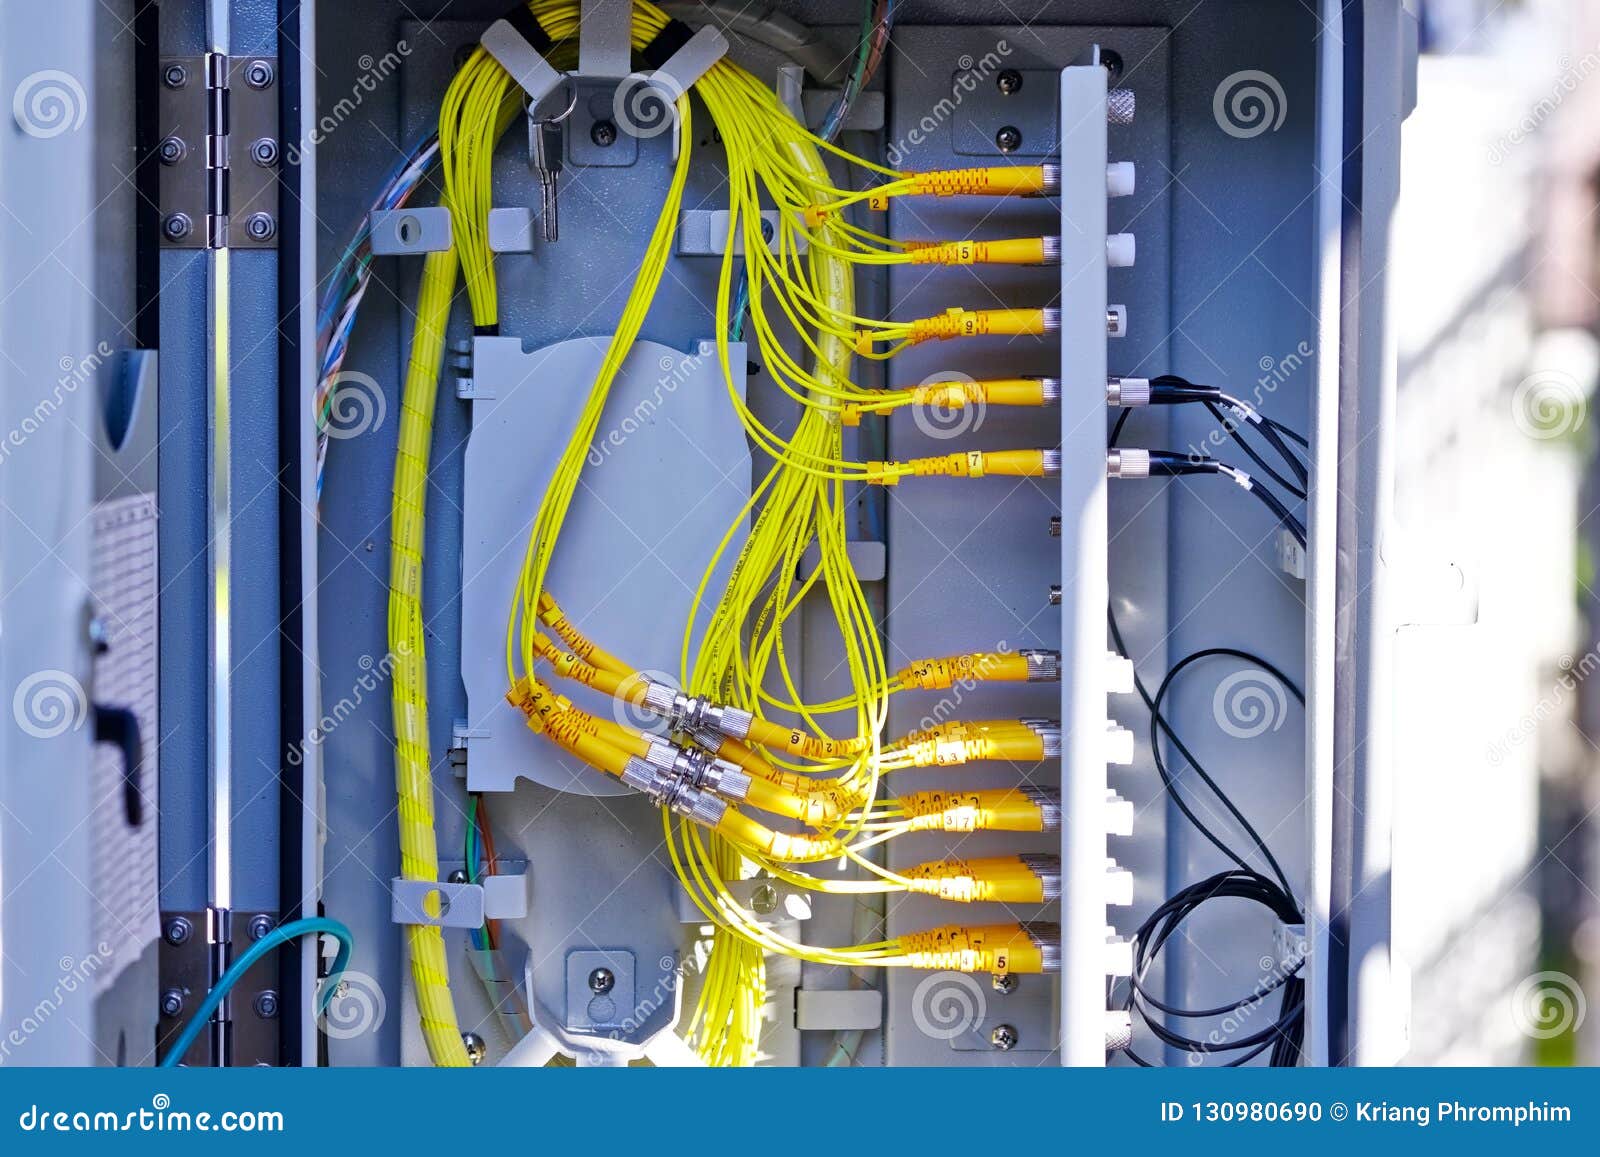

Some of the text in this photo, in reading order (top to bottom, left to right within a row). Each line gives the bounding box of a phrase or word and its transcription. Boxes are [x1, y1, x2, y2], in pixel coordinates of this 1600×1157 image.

[872, 199, 880, 209] 2
[962, 247, 969, 259] 5
[971, 454, 979, 466] 7
[997, 956, 1006, 969] 5
